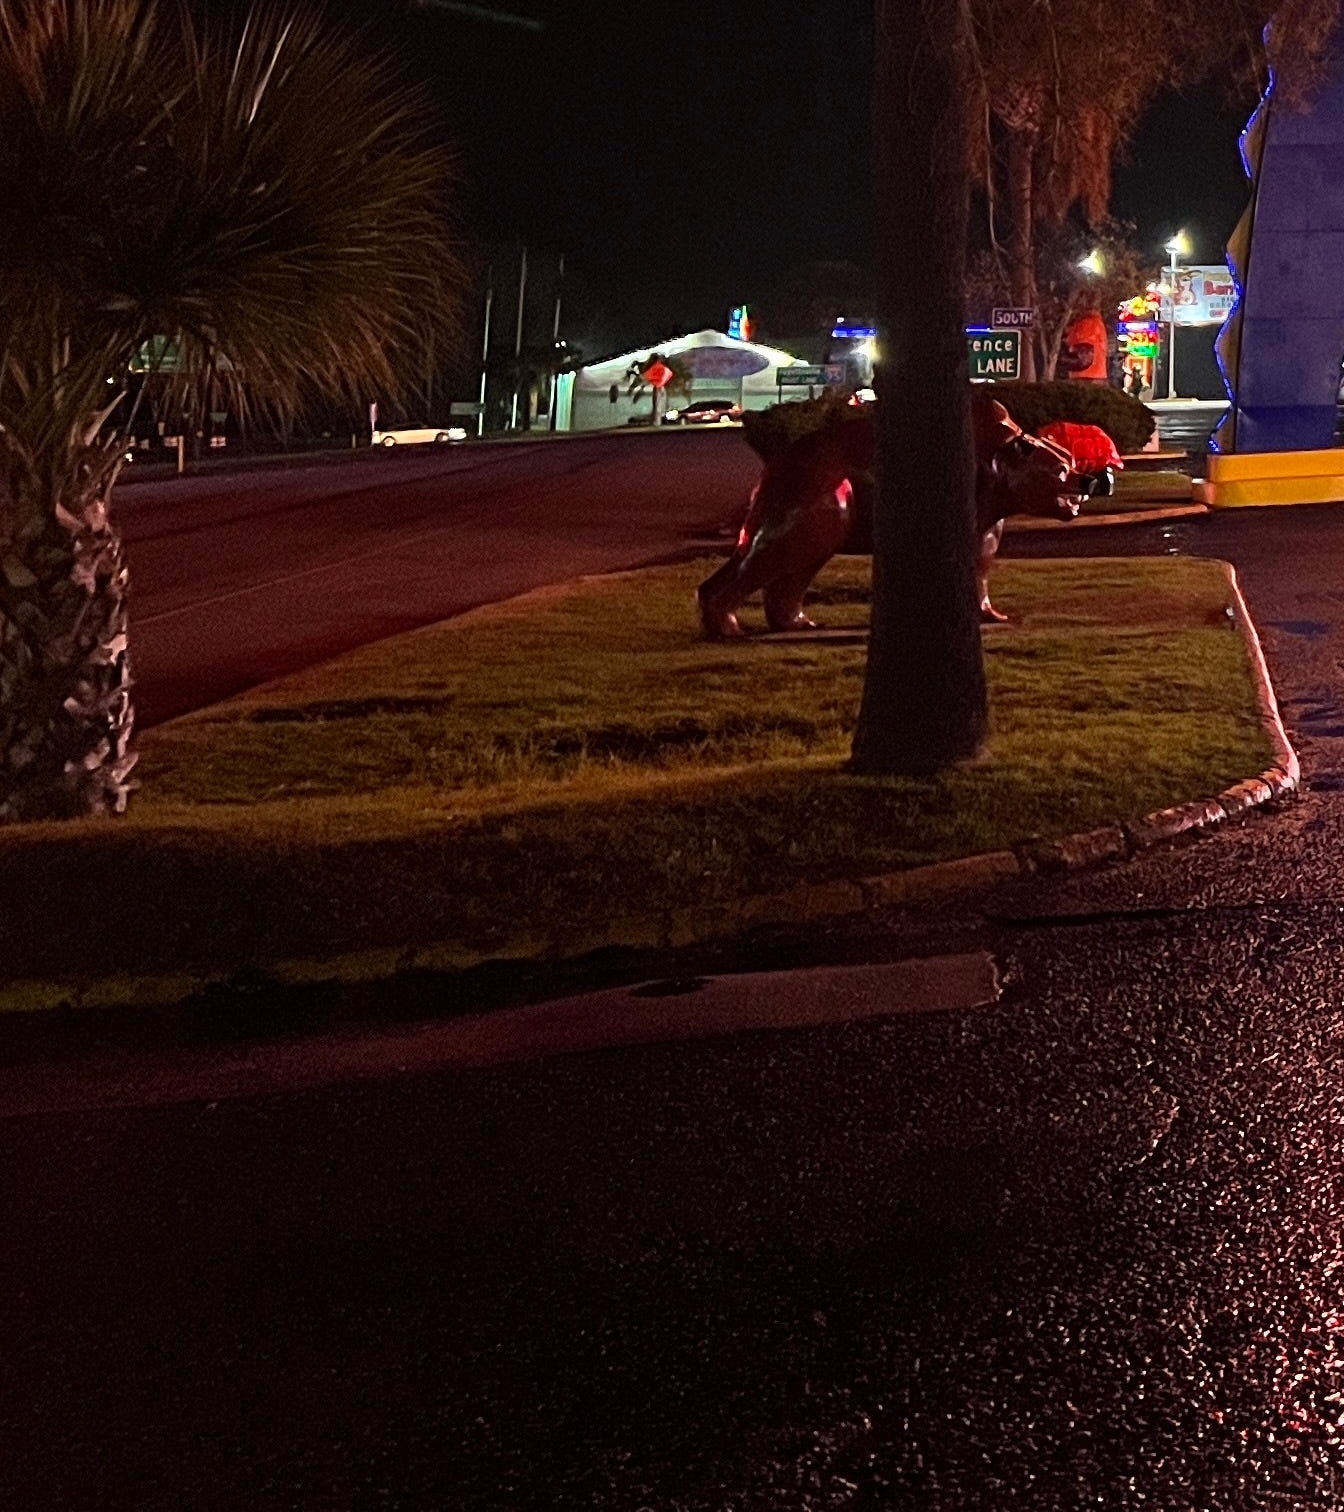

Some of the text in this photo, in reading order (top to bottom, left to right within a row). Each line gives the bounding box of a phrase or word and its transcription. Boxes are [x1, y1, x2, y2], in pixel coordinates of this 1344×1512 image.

[995, 311, 1033, 324] SOUTH
[968, 339, 1013, 352] ence
[977, 357, 1015, 374] LANE
